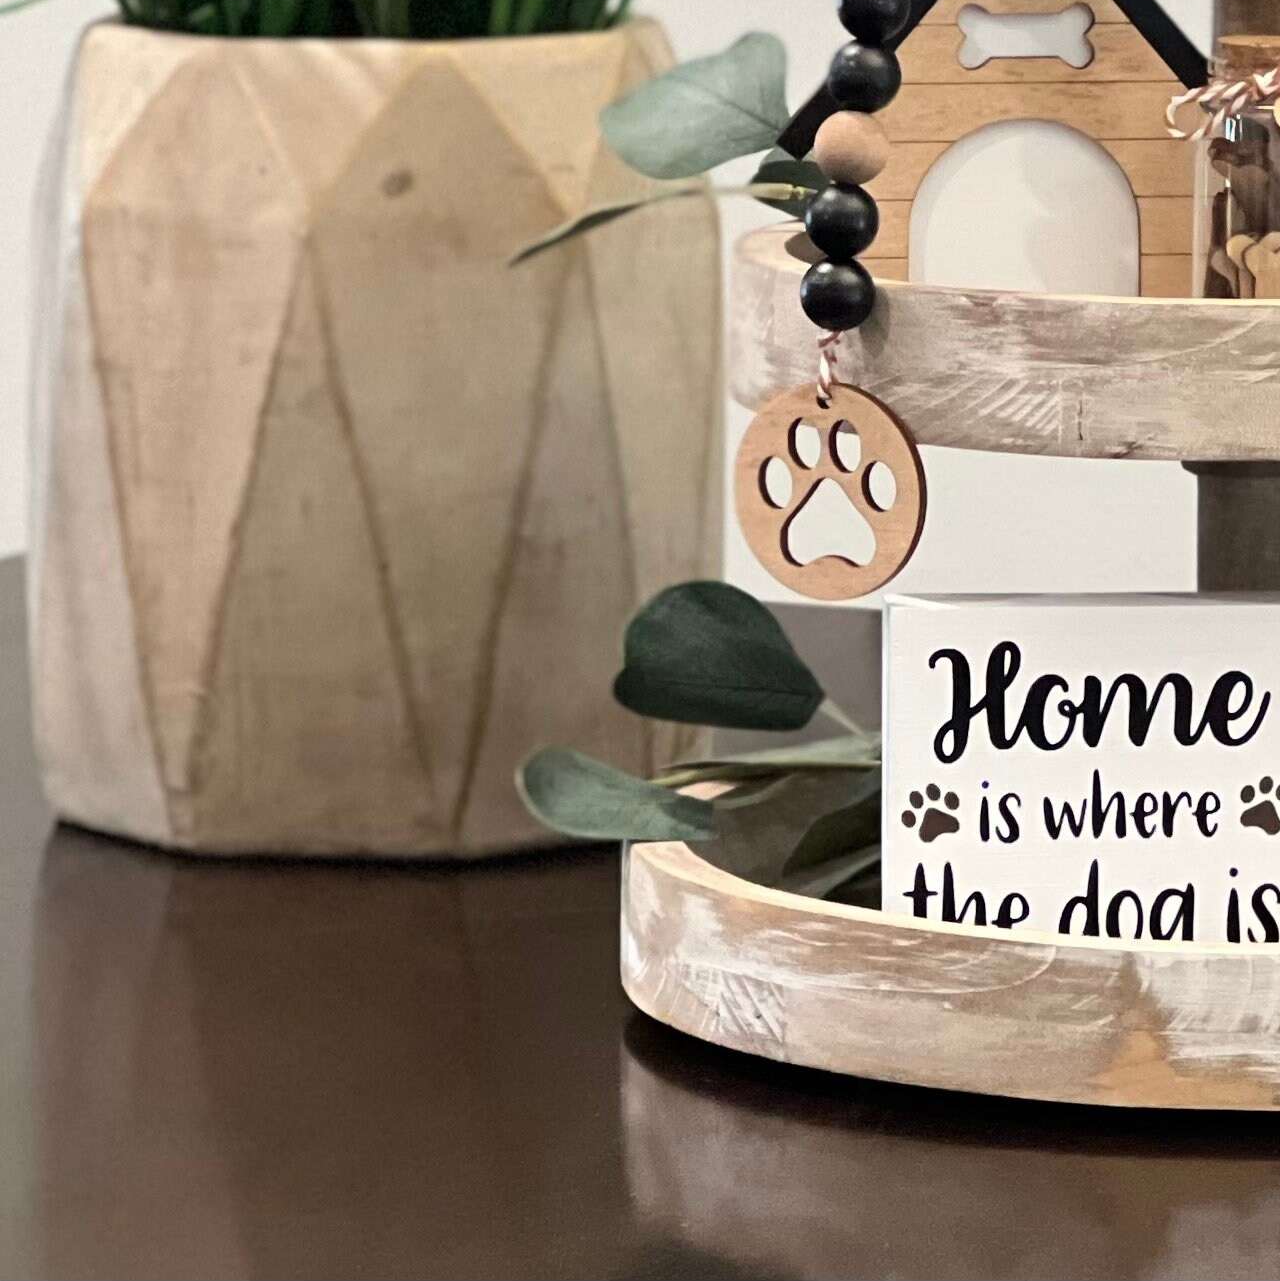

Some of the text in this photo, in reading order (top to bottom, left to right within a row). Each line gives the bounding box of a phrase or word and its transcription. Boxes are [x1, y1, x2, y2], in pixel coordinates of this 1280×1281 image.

[928, 640, 1271, 764] Home
[979, 768, 1221, 844] is where
[901, 861, 1031, 930] the
